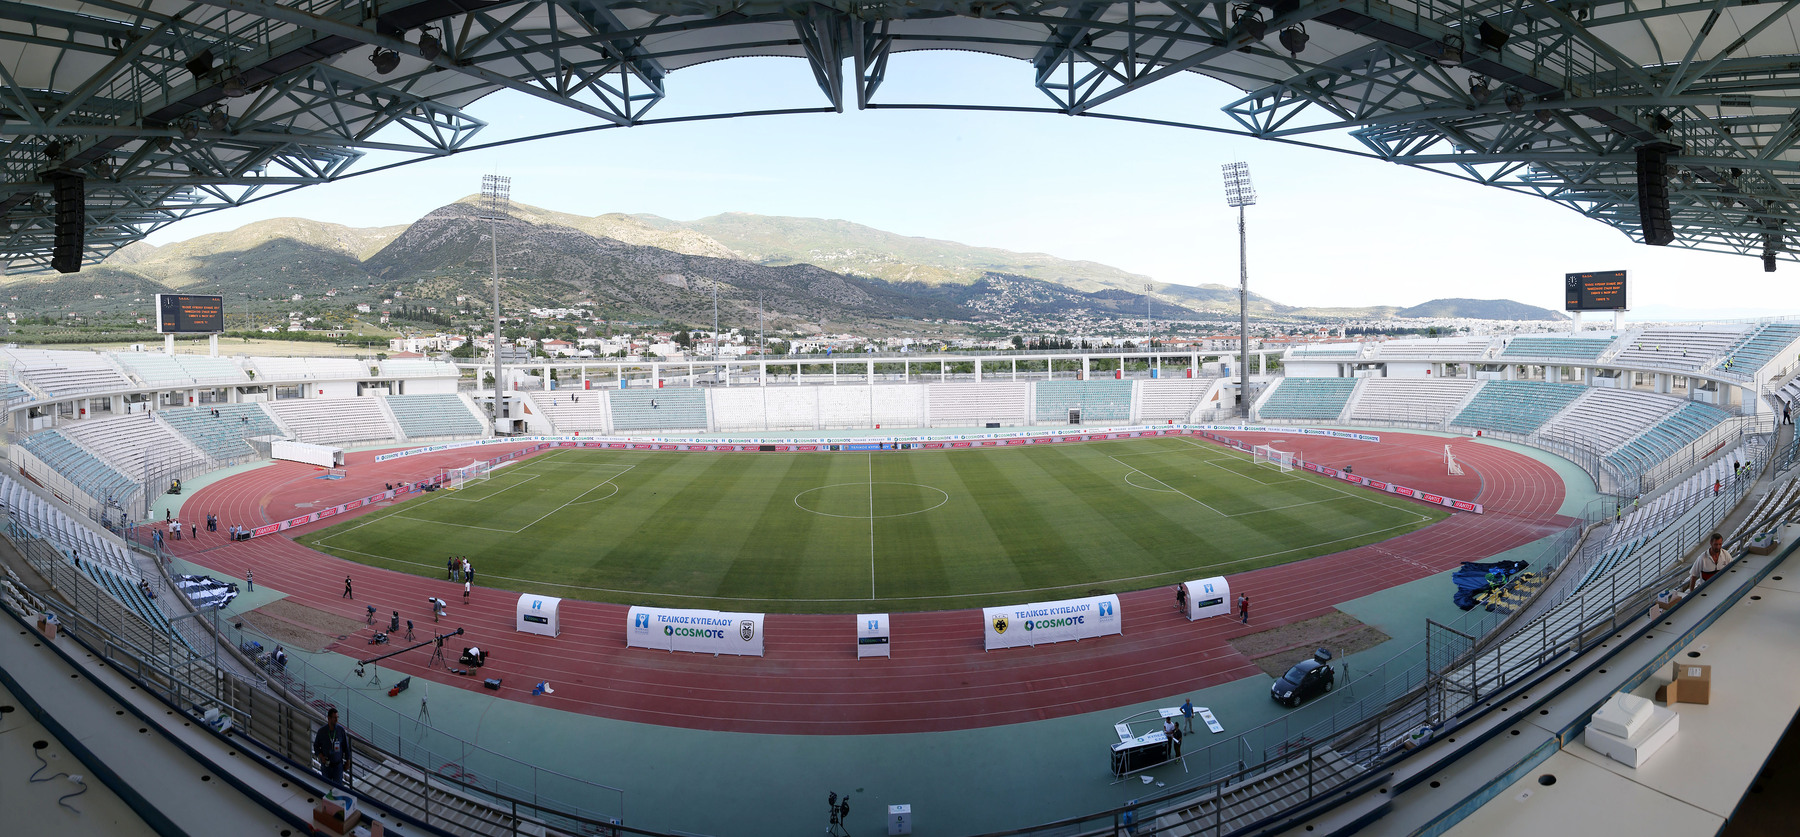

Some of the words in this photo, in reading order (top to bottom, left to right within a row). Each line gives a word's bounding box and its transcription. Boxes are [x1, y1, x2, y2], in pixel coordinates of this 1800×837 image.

[1015, 609, 1049, 619] ΤΕΛΙΚΟΣ
[1050, 604, 1090, 616] ΚΥΠΕΛΛΟΥ
[657, 614, 689, 624] ΤΕΛΙΚΟΣ
[690, 617, 732, 626] ΚΥΠΕΛΛΟΥ
[1035, 615, 1085, 629] COSMOTE
[675, 627, 724, 639] COSMOTE
